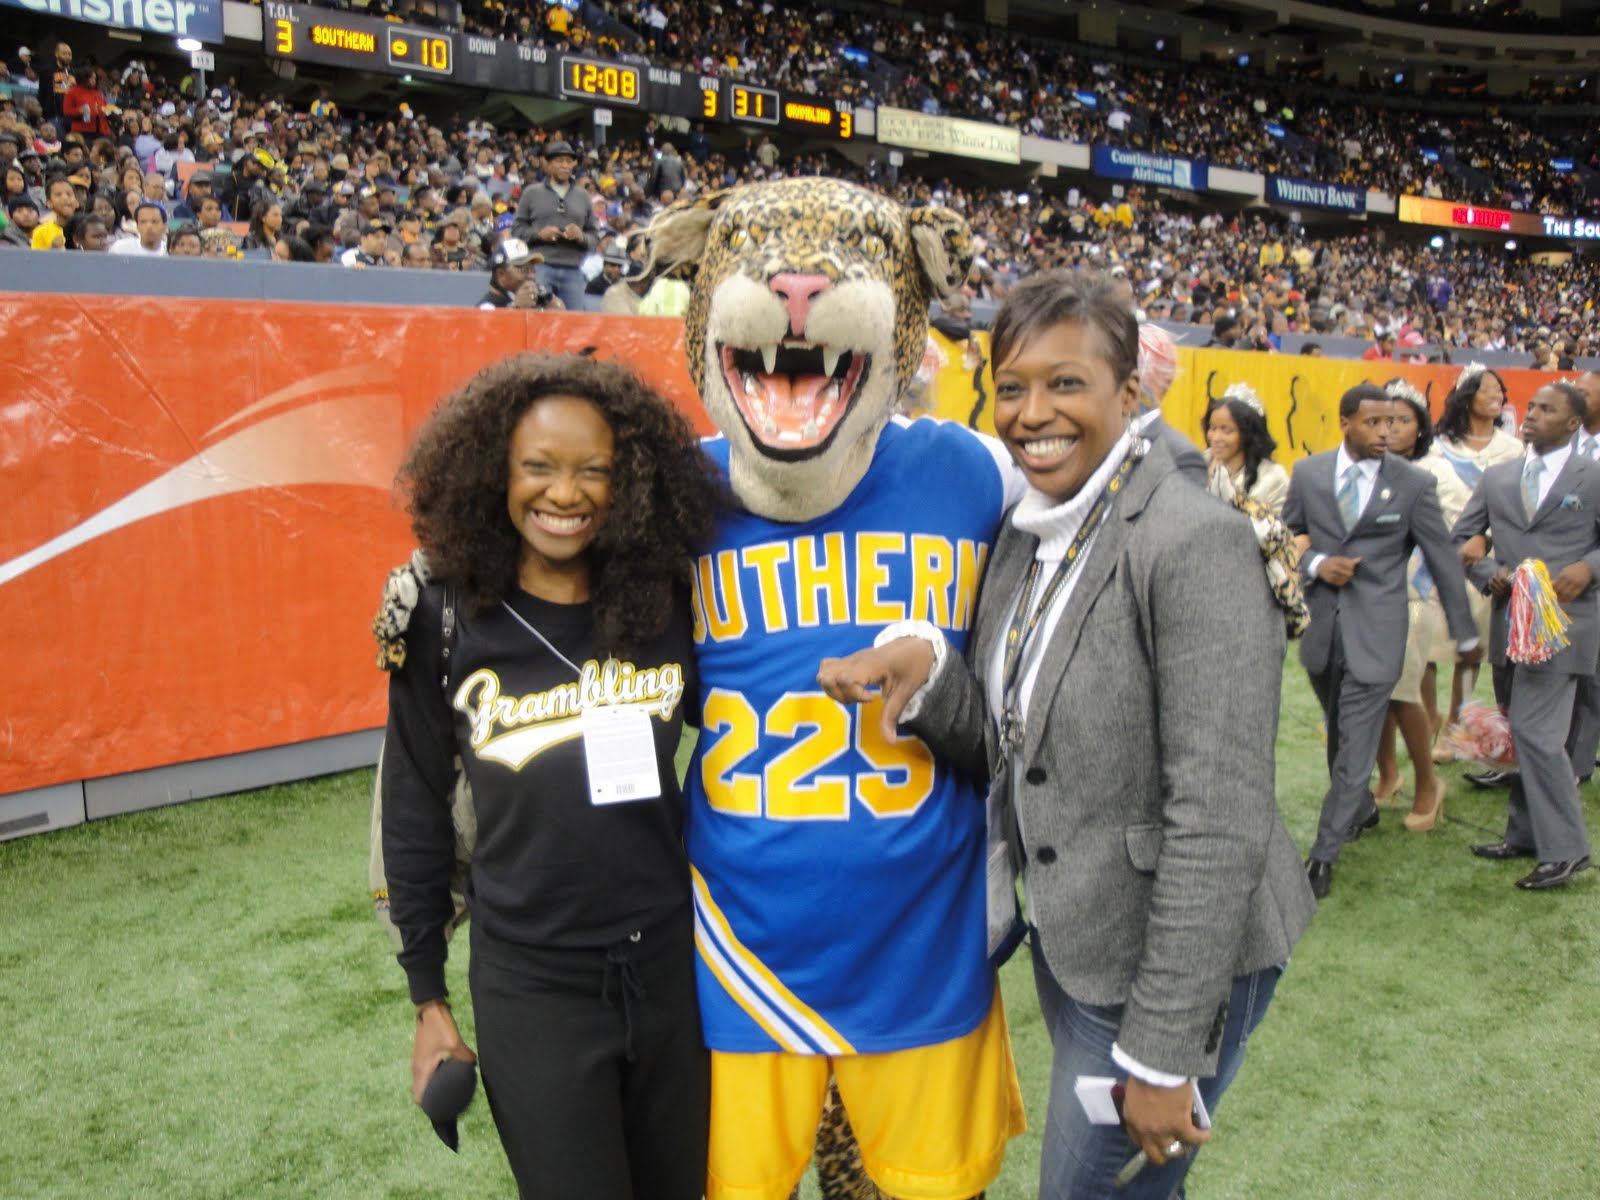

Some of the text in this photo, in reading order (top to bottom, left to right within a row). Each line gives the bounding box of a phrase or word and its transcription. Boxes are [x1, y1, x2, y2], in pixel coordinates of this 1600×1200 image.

[277, 20, 292, 53] 3
[312, 26, 375, 52] SOUTHERN
[469, 38, 496, 55] DOWN
[421, 39, 447, 69] 10
[519, 45, 547, 63] TO GO
[572, 63, 635, 99] 12:08
[649, 67, 681, 86] BALL ON
[700, 76, 719, 91] QTR
[704, 89, 717, 117] 3
[735, 89, 763, 117] 31
[840, 112, 851, 138] 3
[1111, 149, 1172, 171] Continental
[1132, 167, 1172, 185] Airlines
[1276, 178, 1356, 208] WHITNEY BANK
[1543, 215, 1570, 236] THE
[454, 658, 685, 747] Grambling
[701, 687, 936, 821] 225
